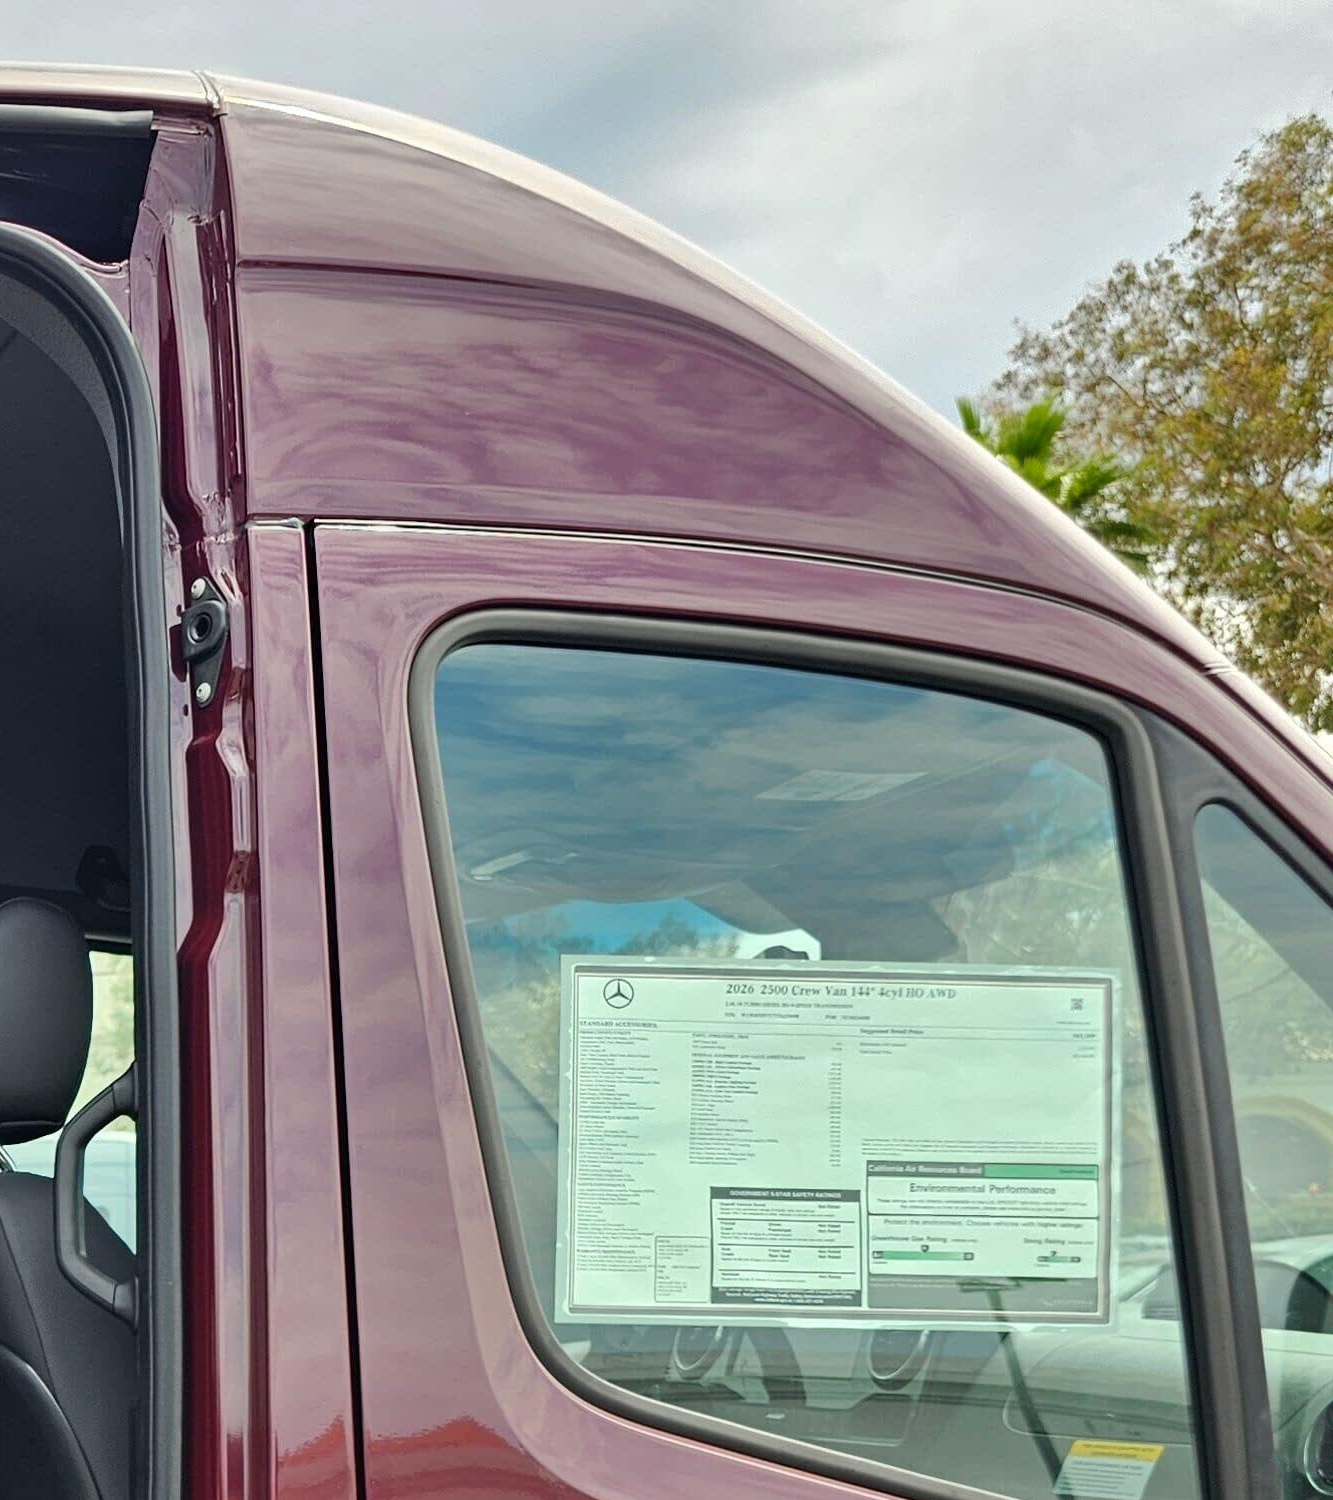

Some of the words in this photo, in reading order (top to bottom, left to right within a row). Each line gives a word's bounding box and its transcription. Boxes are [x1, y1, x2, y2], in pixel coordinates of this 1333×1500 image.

[725, 983, 755, 995] 2026
[759, 984, 789, 996] 2500
[791, 984, 821, 996] Crew
[825, 985, 847, 997] Van
[877, 986, 903, 999] 4cyl
[905, 988, 924, 998] HO
[926, 988, 957, 999] AWD
[868, 1164, 904, 1173] California
[904, 1164, 917, 1173] Air
[917, 1165, 958, 1174] Resources
[958, 1165, 982, 1174] Board
[909, 1182, 986, 1193] Environmental
[989, 1184, 1056, 1195] Performance
[1037, 1221, 1057, 1229] higher
